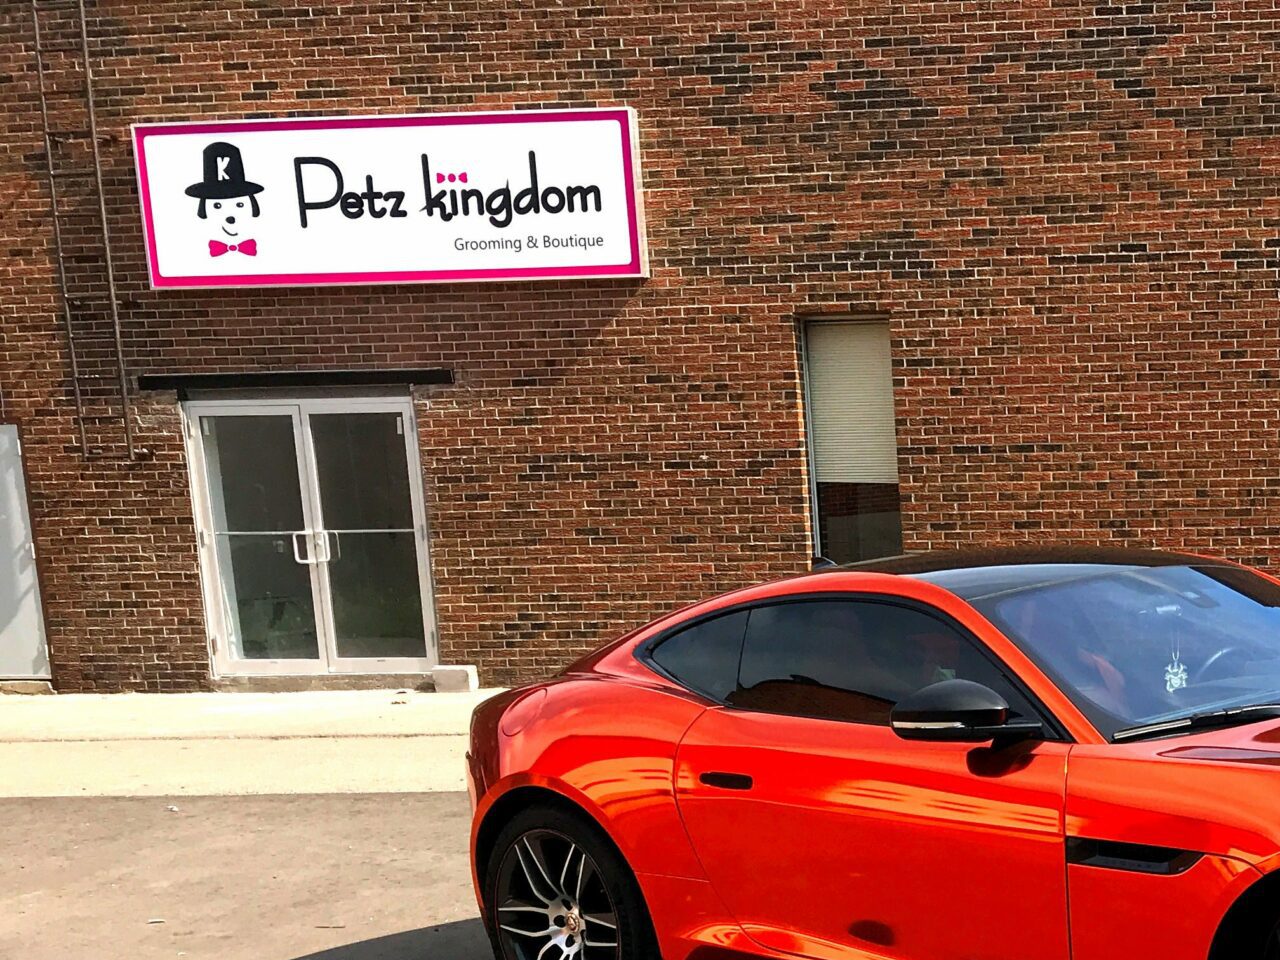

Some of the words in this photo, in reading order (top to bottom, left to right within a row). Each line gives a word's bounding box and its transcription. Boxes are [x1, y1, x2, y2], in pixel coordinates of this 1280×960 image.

[216, 156, 231, 181] K
[293, 156, 408, 229] Petz
[420, 150, 602, 229] kingdom
[454, 237, 522, 253] Grooming
[526, 235, 539, 249] &
[542, 235, 604, 251] Boutique
